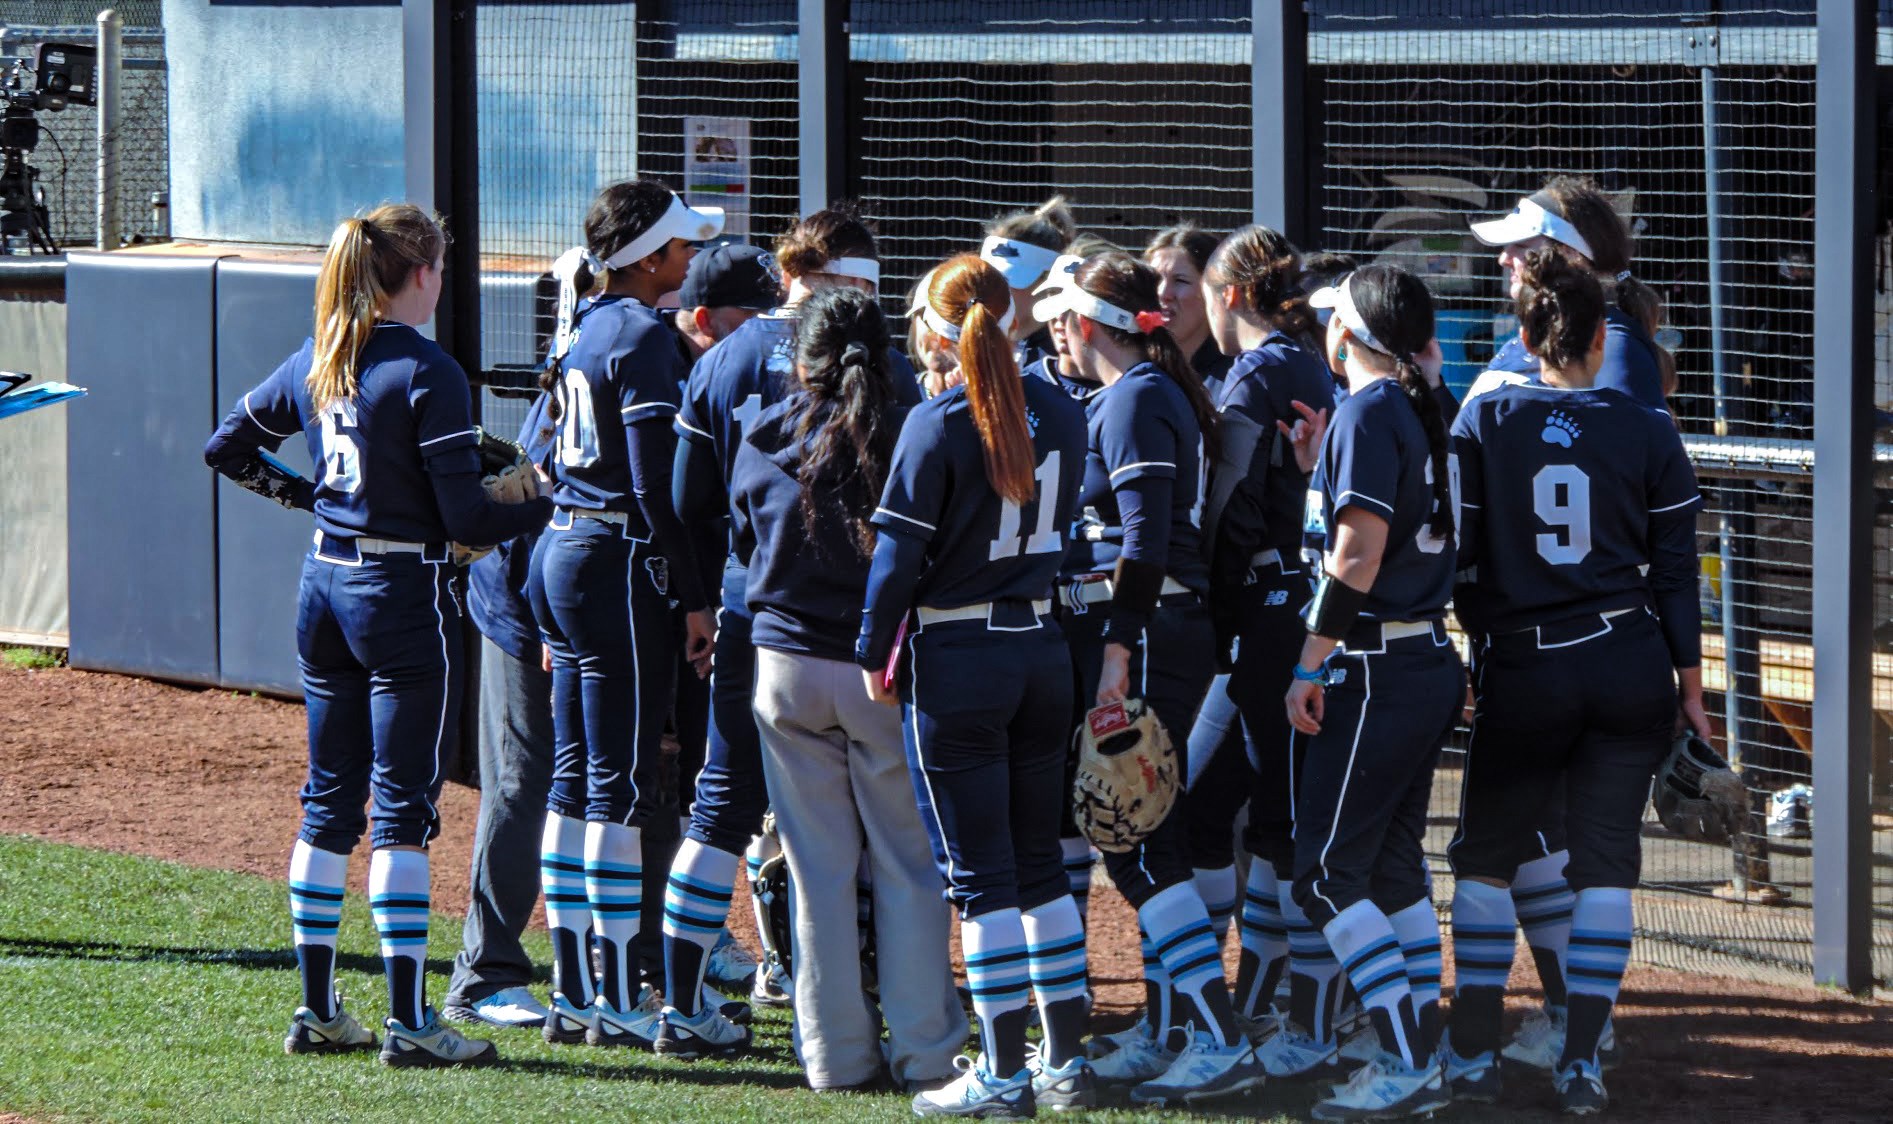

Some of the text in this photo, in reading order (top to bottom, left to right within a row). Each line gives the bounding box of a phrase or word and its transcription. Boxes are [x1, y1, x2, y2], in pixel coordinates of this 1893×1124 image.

[320, 396, 361, 493] 6
[989, 450, 1062, 561] 11
[1533, 464, 1592, 565] 9
[436, 1034, 460, 1056] N
